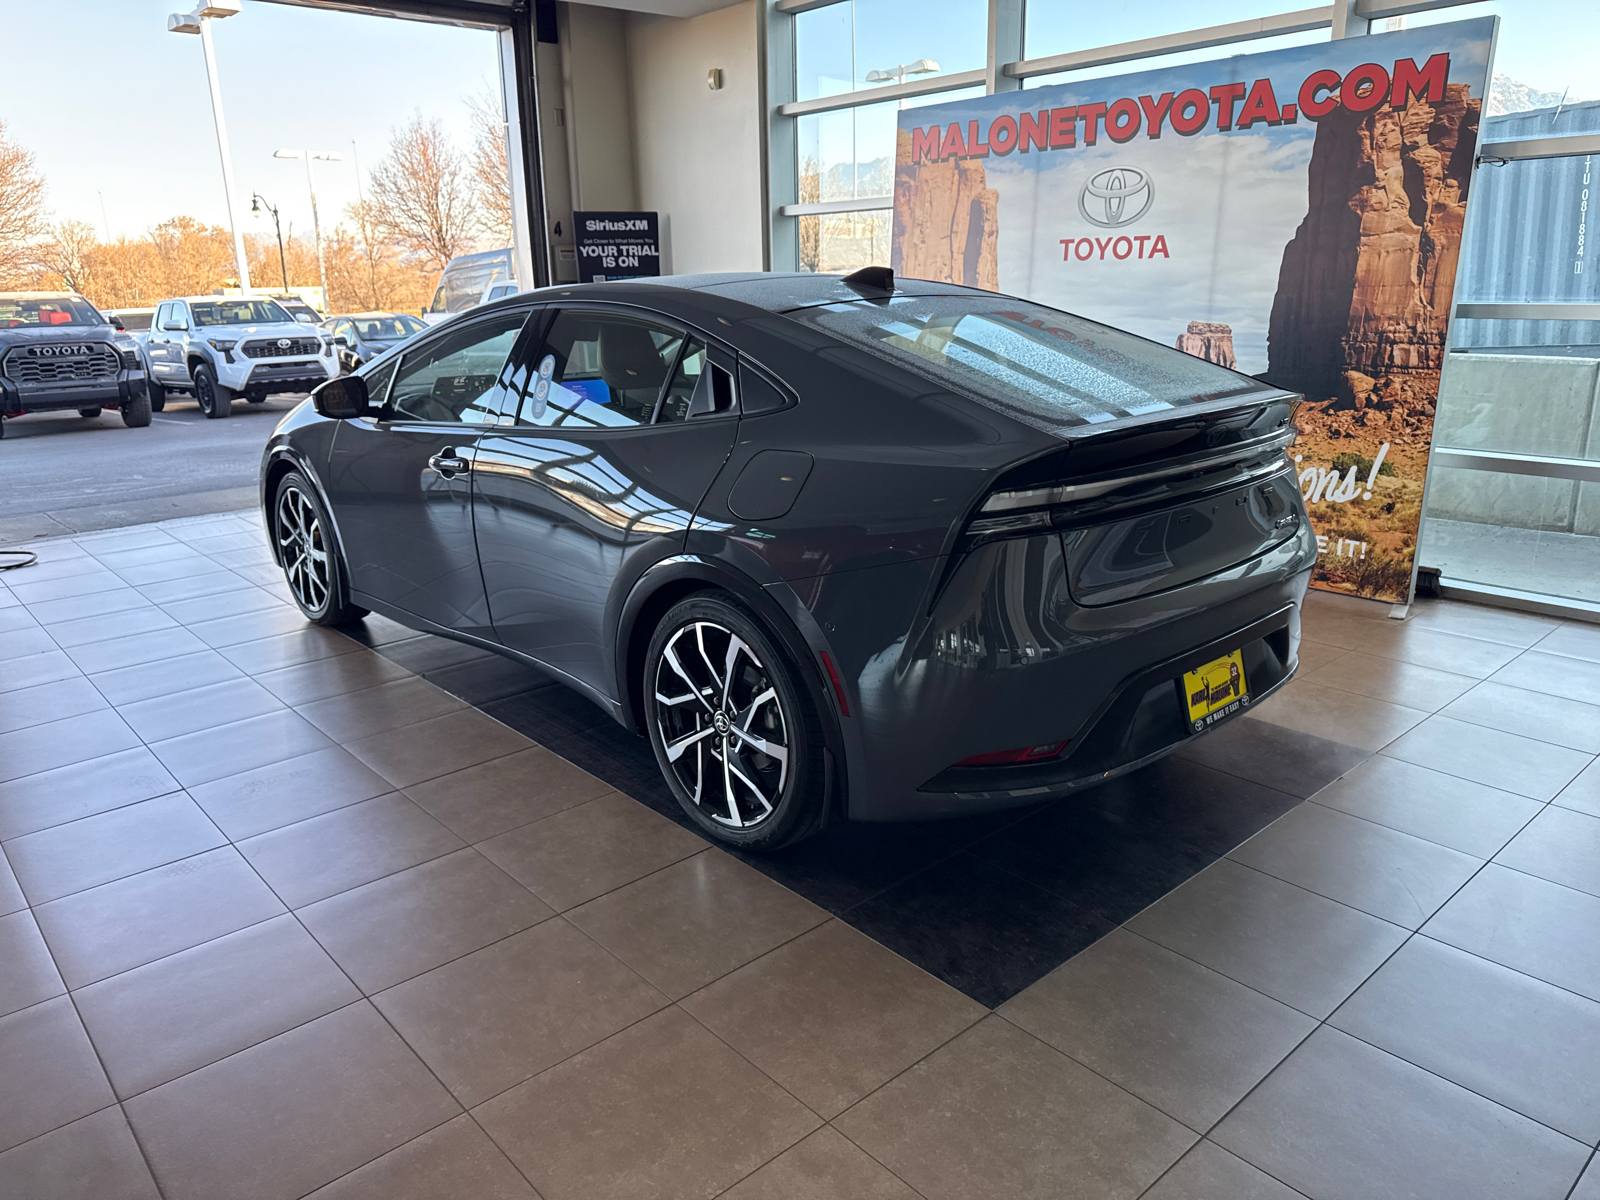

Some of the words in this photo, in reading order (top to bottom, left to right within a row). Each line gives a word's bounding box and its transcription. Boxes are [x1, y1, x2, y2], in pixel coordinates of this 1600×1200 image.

[912, 52, 1450, 165] MALONETOYOTA.COM
[554, 221, 562, 237] 4
[585, 219, 648, 231] SiriusXM
[579, 245, 618, 257] YOUR
[619, 245, 659, 256] TRIAL
[1059, 235, 1170, 262] TOYOTA
[602, 257, 616, 268] IS
[618, 256, 639, 267] ON
[33, 345, 89, 356] TOYOTA
[1337, 538, 1367, 560] IT!
[1205, 716, 1213, 724] WE
[1213, 709, 1225, 721] MAKE
